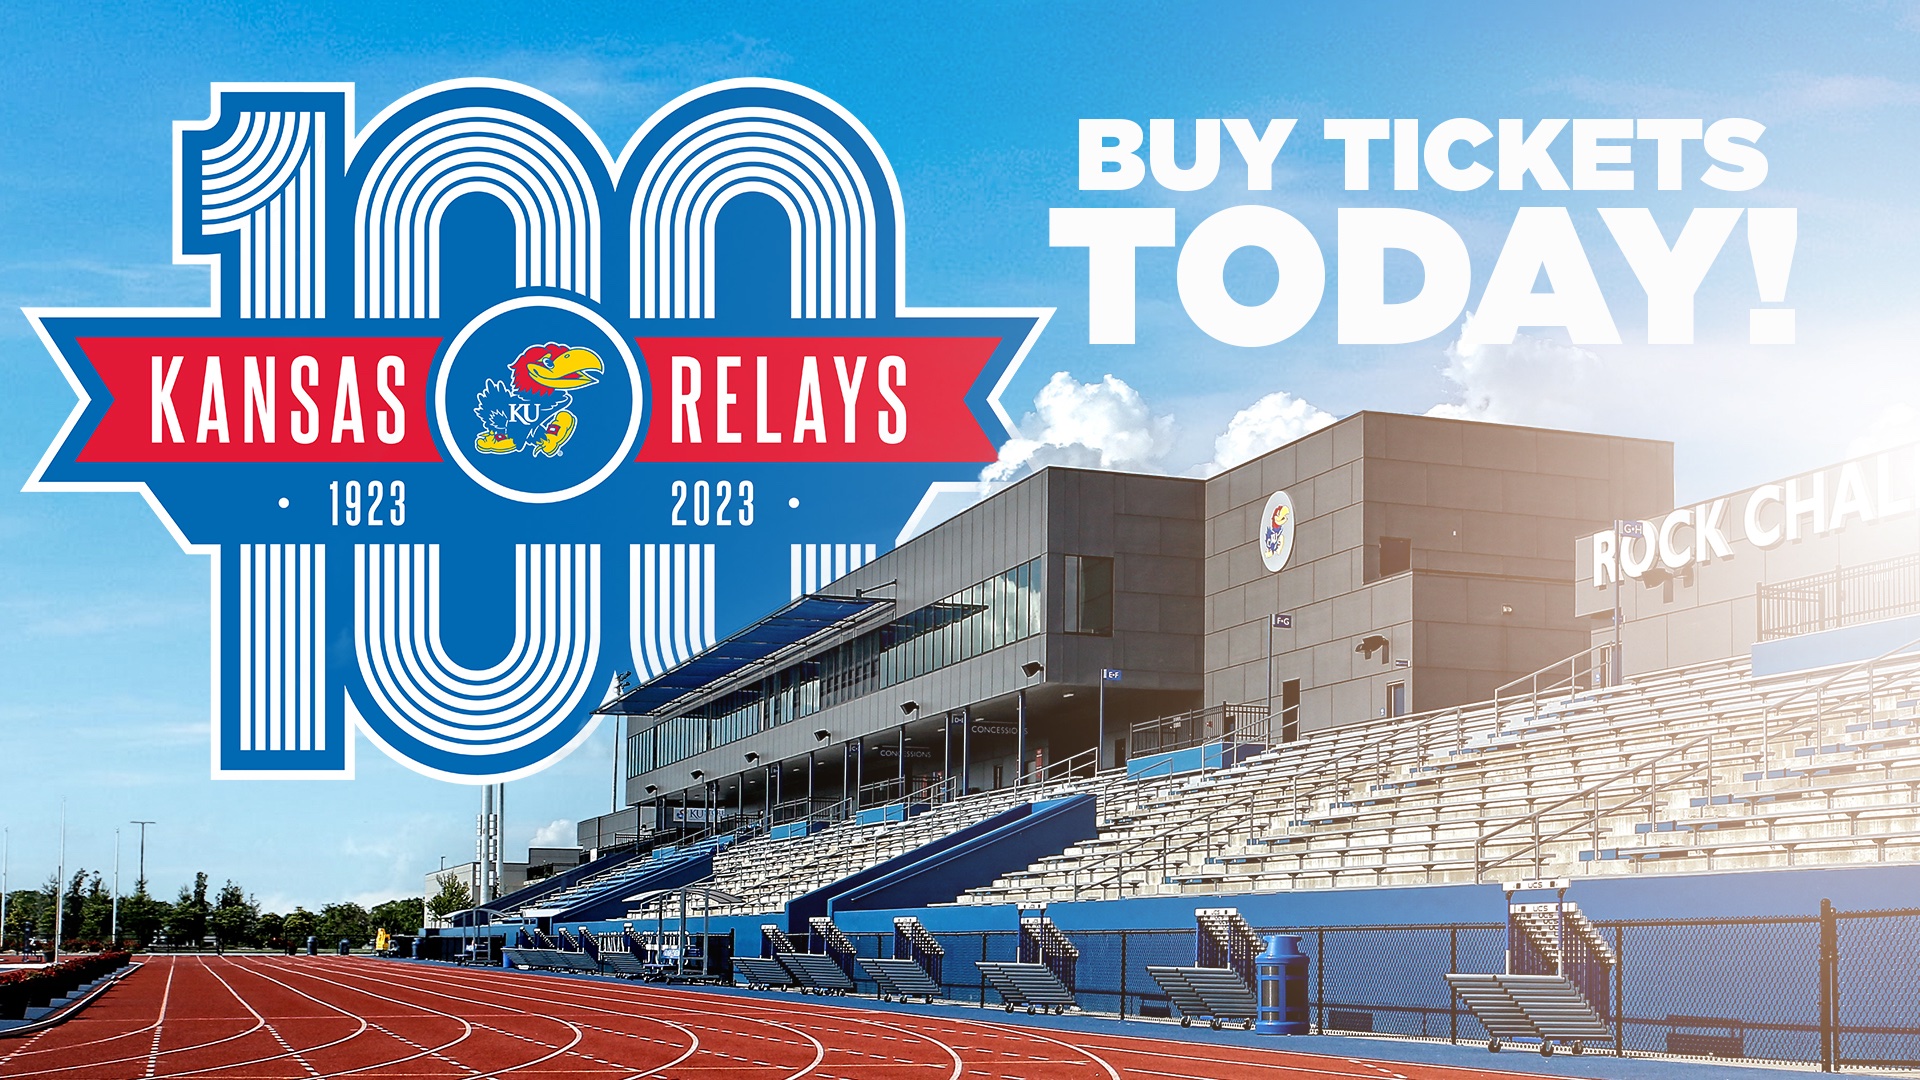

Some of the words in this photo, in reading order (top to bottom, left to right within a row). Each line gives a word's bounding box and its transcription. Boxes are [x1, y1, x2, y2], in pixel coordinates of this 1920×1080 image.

[1593, 497, 1735, 587] ROCK
[1744, 442, 1920, 548] CHAL
[971, 725, 1028, 735] CONCESSIOS
[880, 749, 931, 758] CONESSIONS
[1528, 881, 1543, 889] UCS
